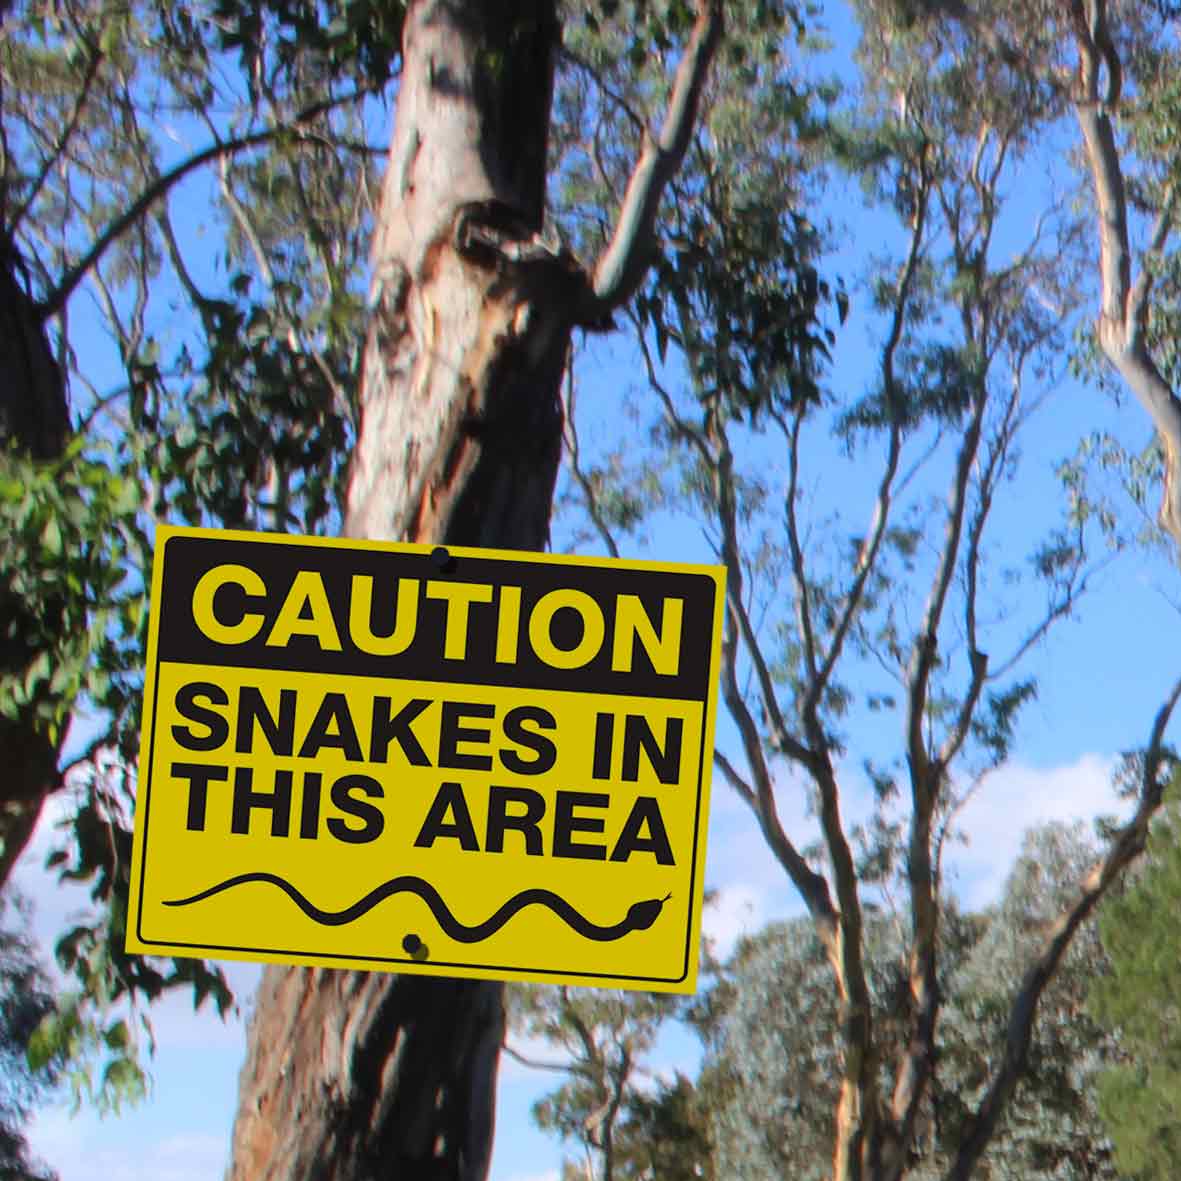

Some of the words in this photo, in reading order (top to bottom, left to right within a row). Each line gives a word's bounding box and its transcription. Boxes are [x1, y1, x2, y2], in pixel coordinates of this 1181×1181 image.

[192, 564, 683, 676] CAUTION
[171, 682, 557, 775] SNAKES
[592, 712, 683, 785] IN
[171, 763, 385, 844] THIS
[414, 782, 676, 866] AREA
